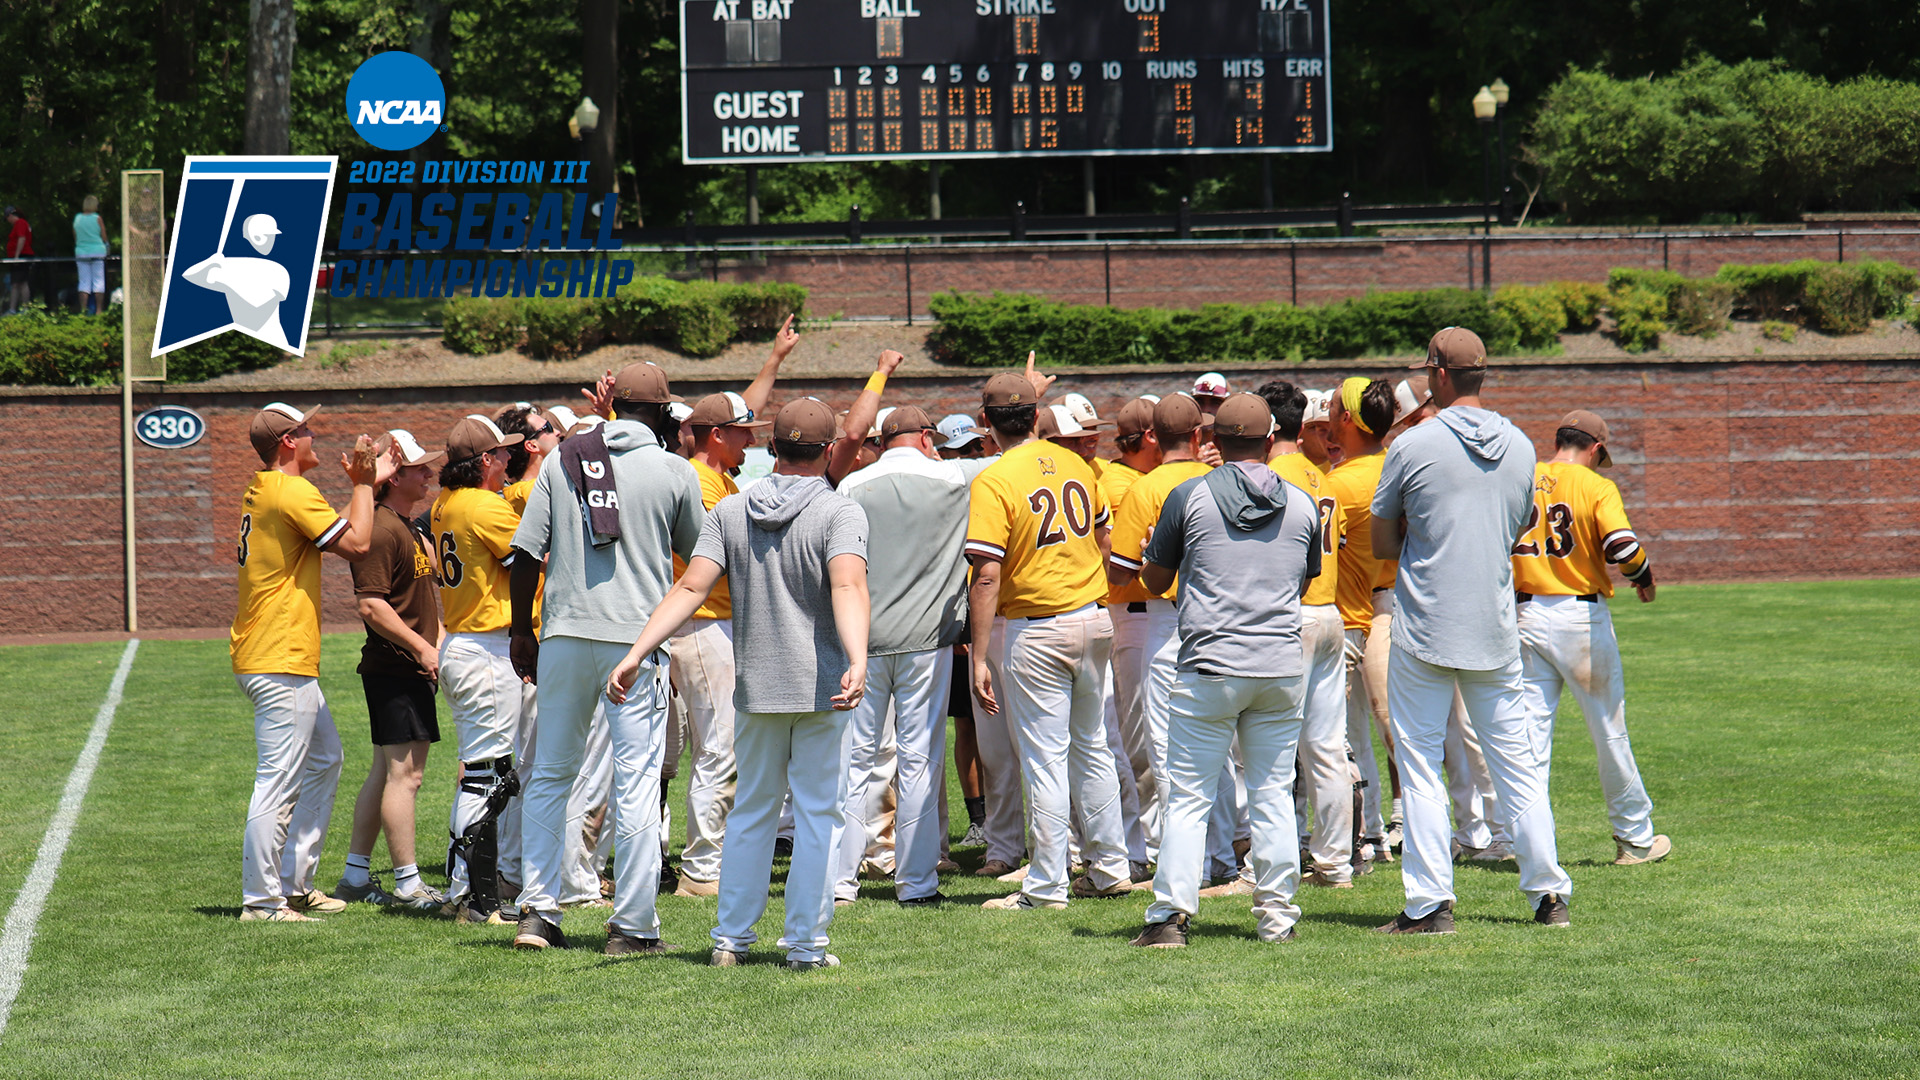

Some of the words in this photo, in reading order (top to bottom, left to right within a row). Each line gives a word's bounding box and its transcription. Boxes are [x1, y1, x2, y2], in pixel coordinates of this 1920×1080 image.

[713, 0, 740, 20] AT
[752, 0, 794, 20] BAT
[861, 0, 920, 18] BALL
[976, 0, 1057, 16] STRIKE
[880, 20, 902, 57] 0
[1016, 17, 1038, 55] 0
[1137, 14, 1160, 52] 3
[834, 67, 842, 86] 1
[858, 66, 872, 86] 2
[885, 65, 899, 85] 3
[921, 65, 937, 83] 4
[950, 64, 963, 83] 5
[976, 64, 991, 83] 6
[1015, 62, 1029, 82] 7
[1041, 62, 1055, 82] 8
[1068, 61, 1082, 80] 9
[1102, 61, 1122, 80] 10
[1146, 60, 1198, 79] RUNS
[1222, 59, 1265, 78] HITS
[1285, 58, 1323, 77] ERR
[713, 90, 804, 120] GUEST
[829, 90, 847, 118] 0
[856, 89, 873, 117] 0
[948, 87, 965, 116] 0
[975, 87, 992, 115] 0
[1012, 86, 1030, 114] 0
[1039, 85, 1057, 114] 0
[1066, 85, 1083, 113] 0
[1174, 83, 1192, 111] 0
[1245, 82, 1263, 110] 4
[1306, 81, 1312, 109] 1
[721, 125, 801, 153] HOME
[144, 415, 196, 440] 330
[1027, 479, 1092, 550] 20
[1511, 502, 1577, 559] 23
